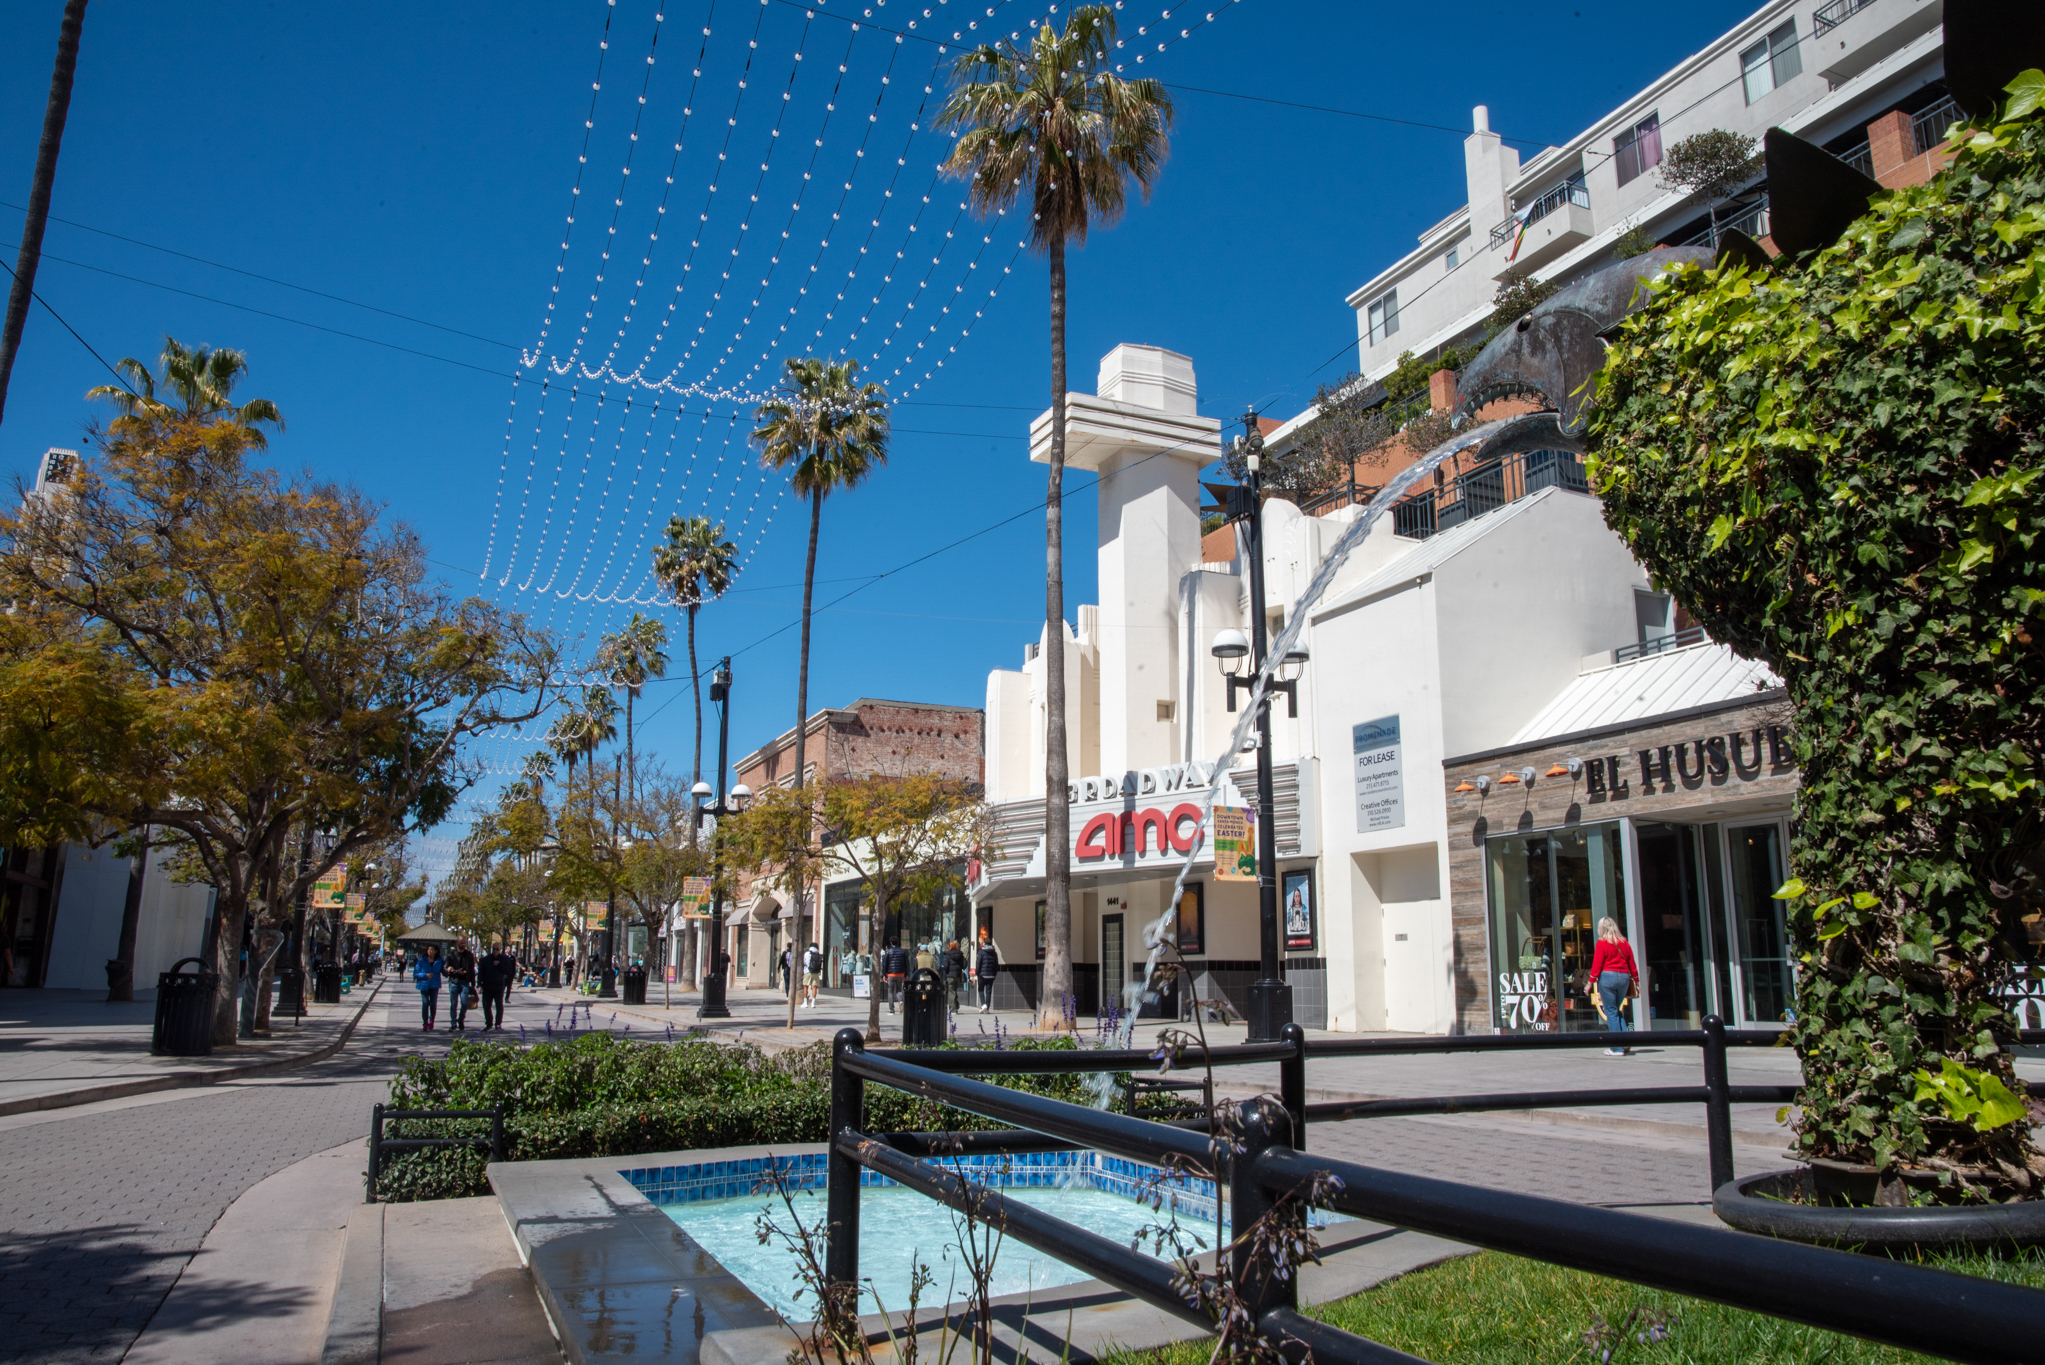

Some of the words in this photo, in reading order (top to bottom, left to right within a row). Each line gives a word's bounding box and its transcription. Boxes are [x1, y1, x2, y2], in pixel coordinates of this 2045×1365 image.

[1355, 726, 1396, 743] PROMENADE
[1359, 755, 1373, 767] FOR
[1373, 750, 1395, 764] LEASE
[1357, 775, 1372, 783] Luxury
[1371, 770, 1399, 781] Apartments
[1584, 755, 1628, 794] EL
[1361, 801, 1380, 810] Creative
[1380, 798, 1398, 807] Offices
[1075, 803, 1205, 858] amc
[1217, 830, 1245, 838] EASTER!
[1499, 972, 1548, 994] SALE
[1505, 993, 1549, 1030] 70%
[1535, 1022, 1550, 1031] OFF
